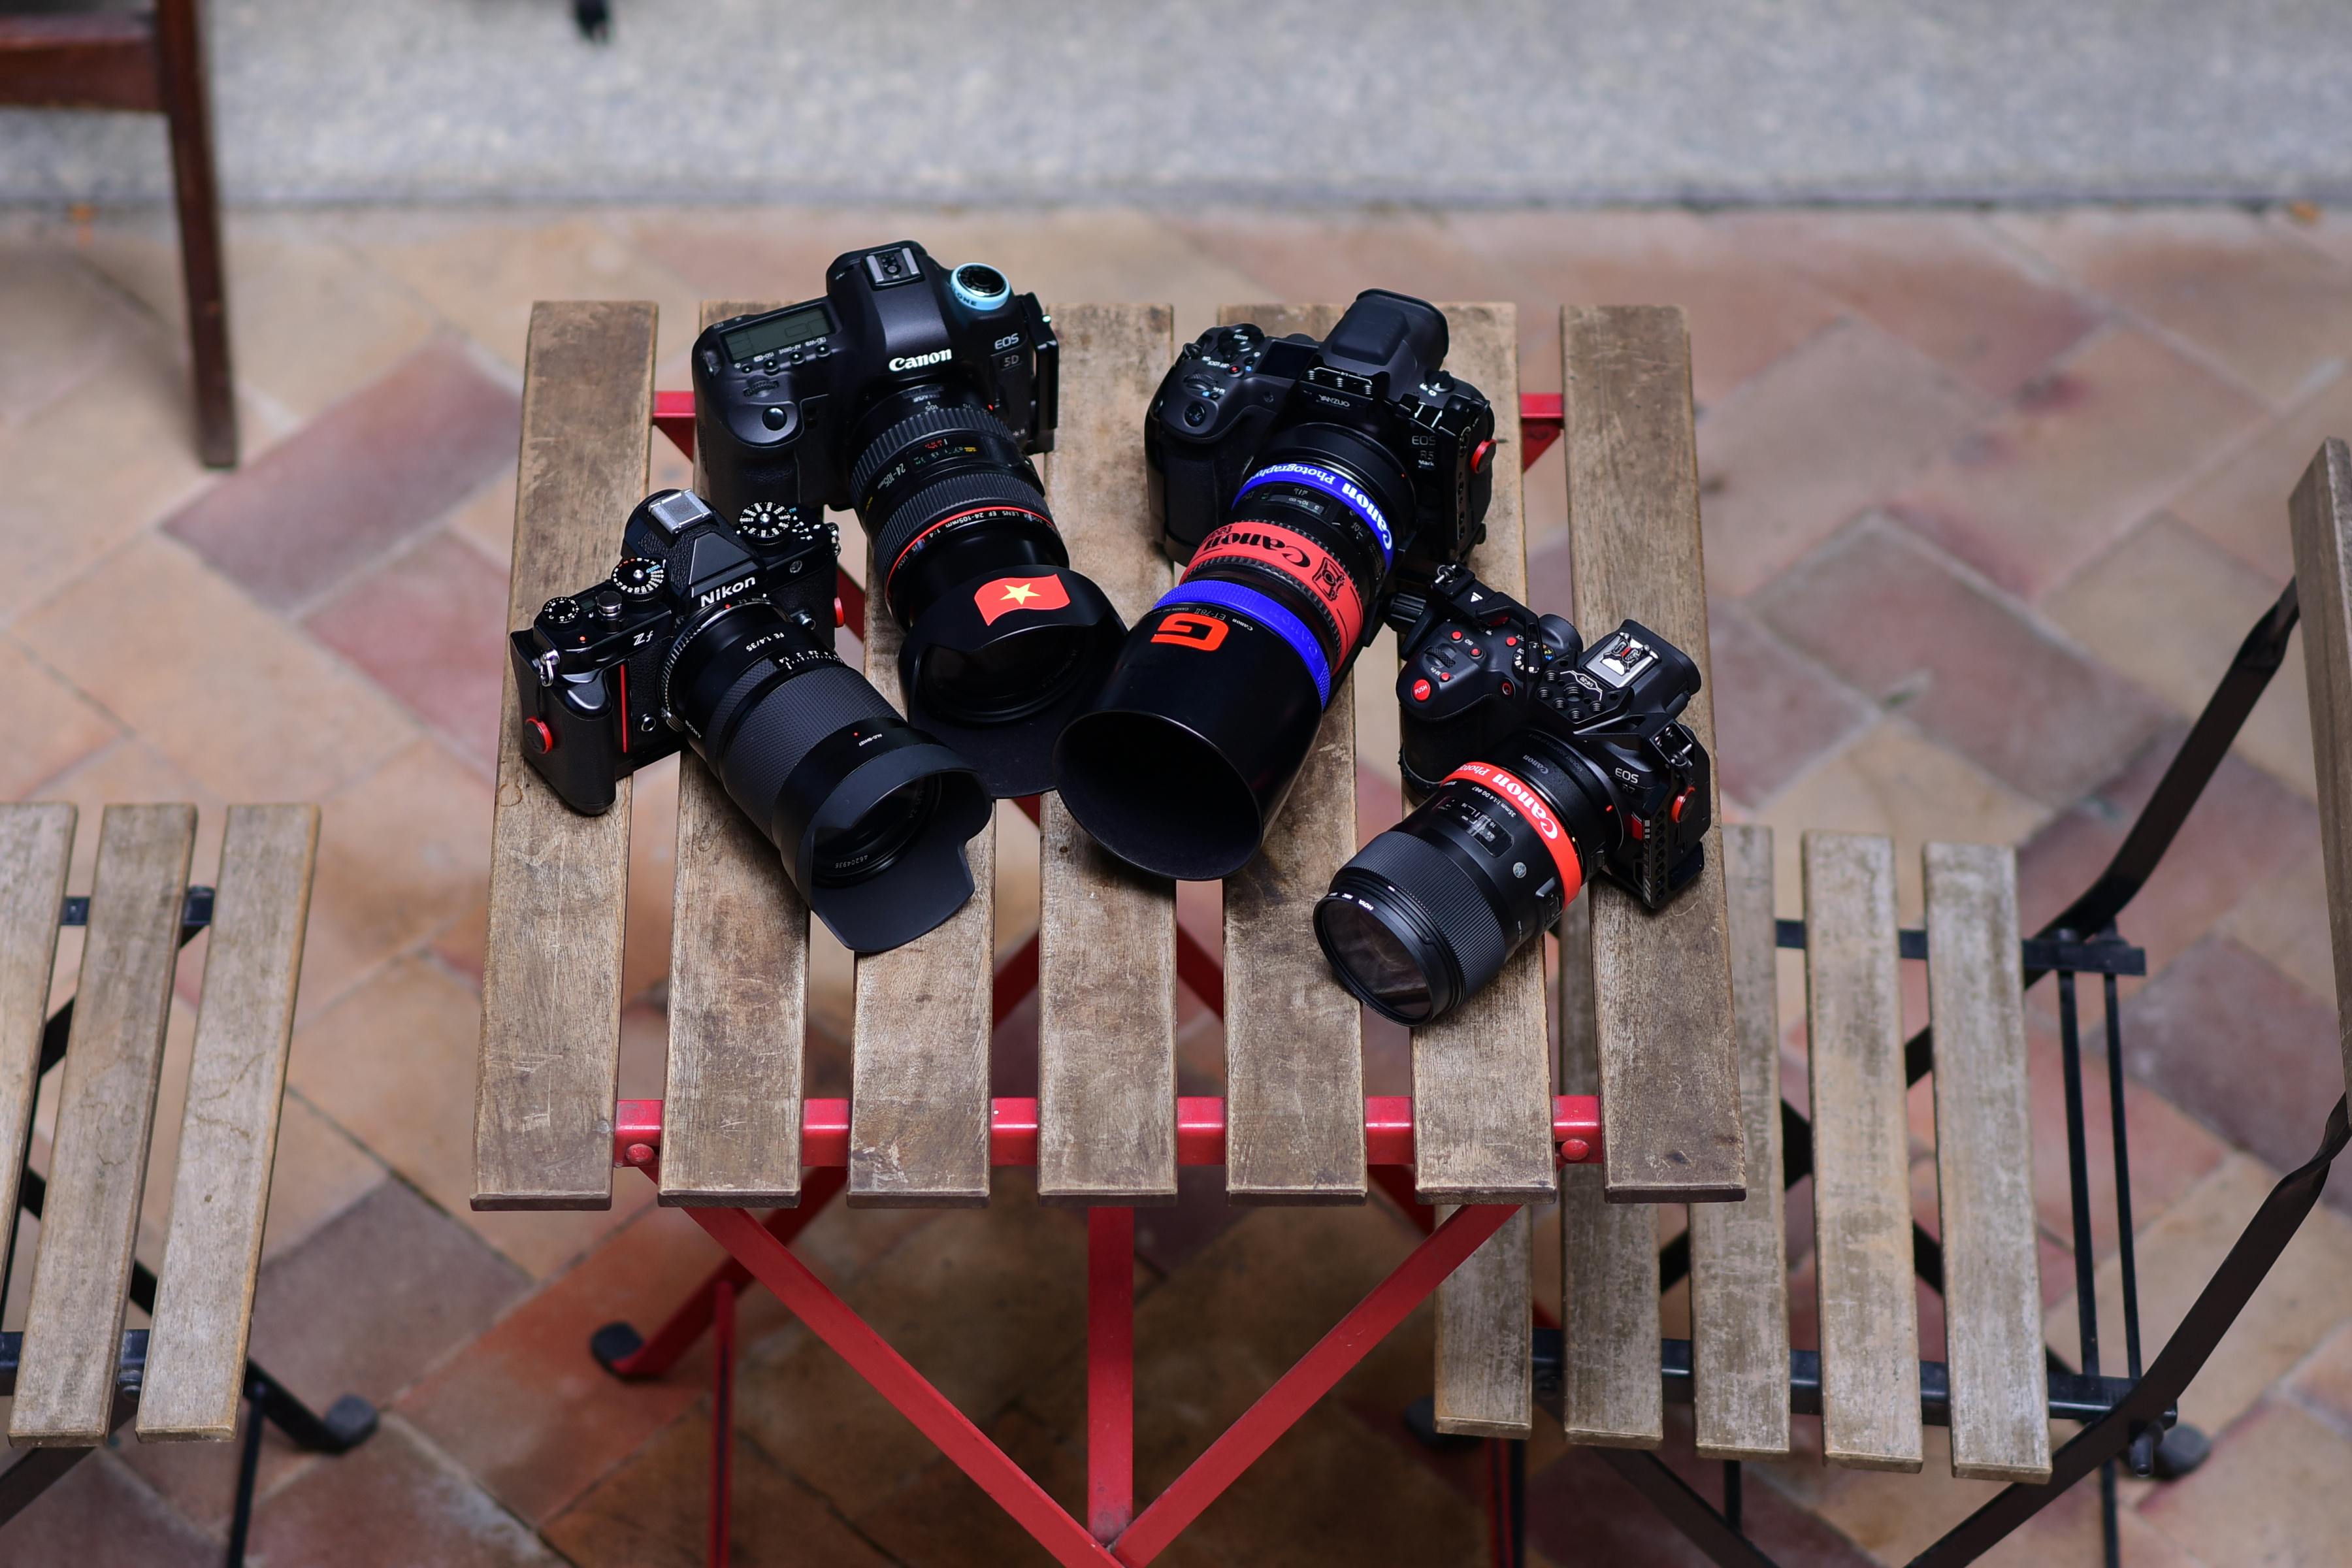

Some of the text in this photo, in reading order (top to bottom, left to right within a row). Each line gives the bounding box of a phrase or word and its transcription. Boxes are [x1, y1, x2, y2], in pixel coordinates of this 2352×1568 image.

[994, 333, 1019, 350] EOS
[889, 348, 953, 372] Canon
[1004, 355, 1019, 367] 5D
[1318, 394, 1350, 407] YANZUO
[1412, 435, 1436, 445] EOS
[945, 512, 985, 528] 24-105mm
[1342, 483, 1392, 550] Canon
[929, 529, 941, 538] 1:4
[1203, 532, 1311, 568] Canon
[700, 576, 757, 608] Nikon
[1232, 618, 1253, 631] Canon
[633, 630, 653, 646] Zf
[745, 636, 772, 652] 1.4/35
[1414, 684, 1428, 695] PUSH
[685, 719, 702, 739] SONY
[1522, 754, 1549, 775] Canon
[1615, 767, 1639, 784] EOS
[1622, 784, 1635, 794] R7
[1492, 774, 1558, 840] Canon
[1501, 803, 1516, 818] 35mm
[1359, 899, 1374, 911] HOYA
